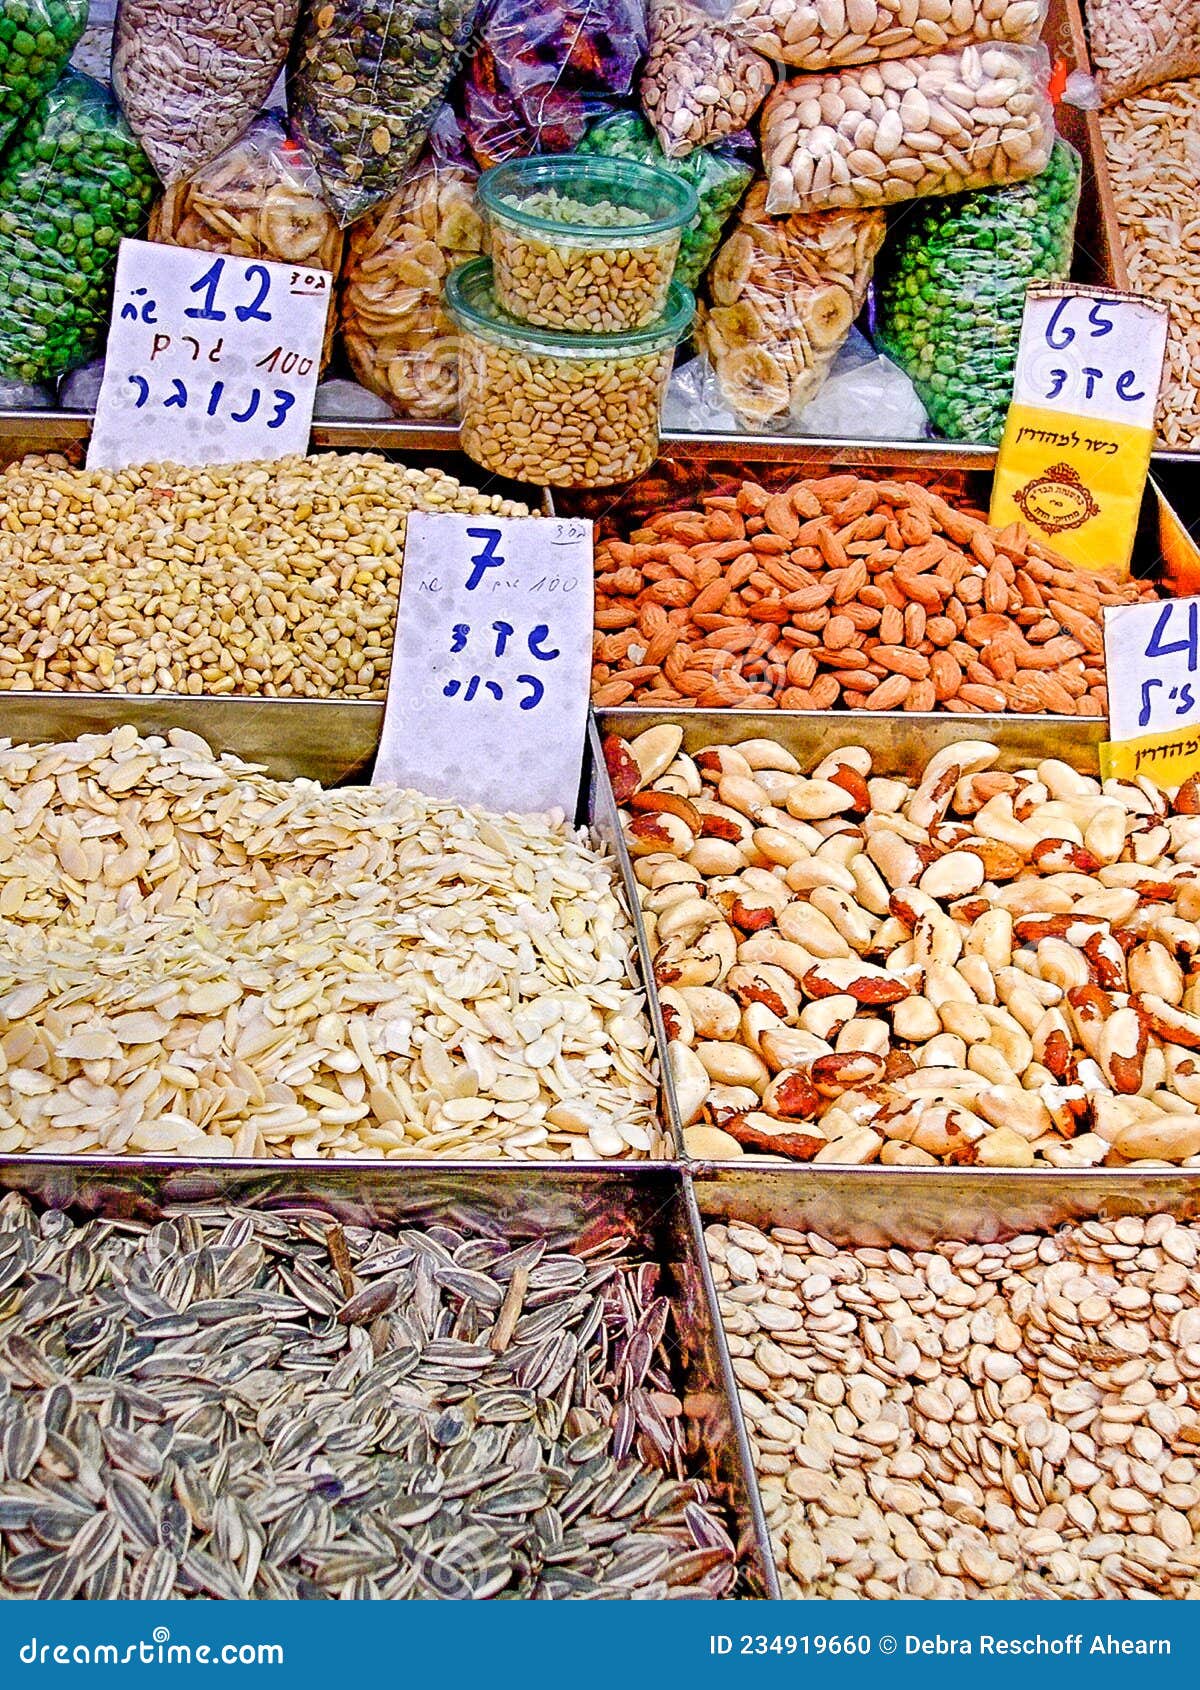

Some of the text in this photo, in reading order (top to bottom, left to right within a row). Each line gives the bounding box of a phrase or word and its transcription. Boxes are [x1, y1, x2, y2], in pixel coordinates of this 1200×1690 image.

[184, 258, 272, 322] 12
[1045, 296, 1120, 350] 65
[149, 333, 313, 376] 100 גרם
[128, 375, 296, 428] צנובר
[1045, 367, 1145, 402] שקד
[1016, 426, 1119, 455] כשר למהדרין
[464, 527, 505, 591] 7
[529, 577, 578, 593] 100
[450, 620, 561, 661] שקד
[1144, 602, 1198, 672] 4
[1135, 735, 1200, 770] מהדרין
